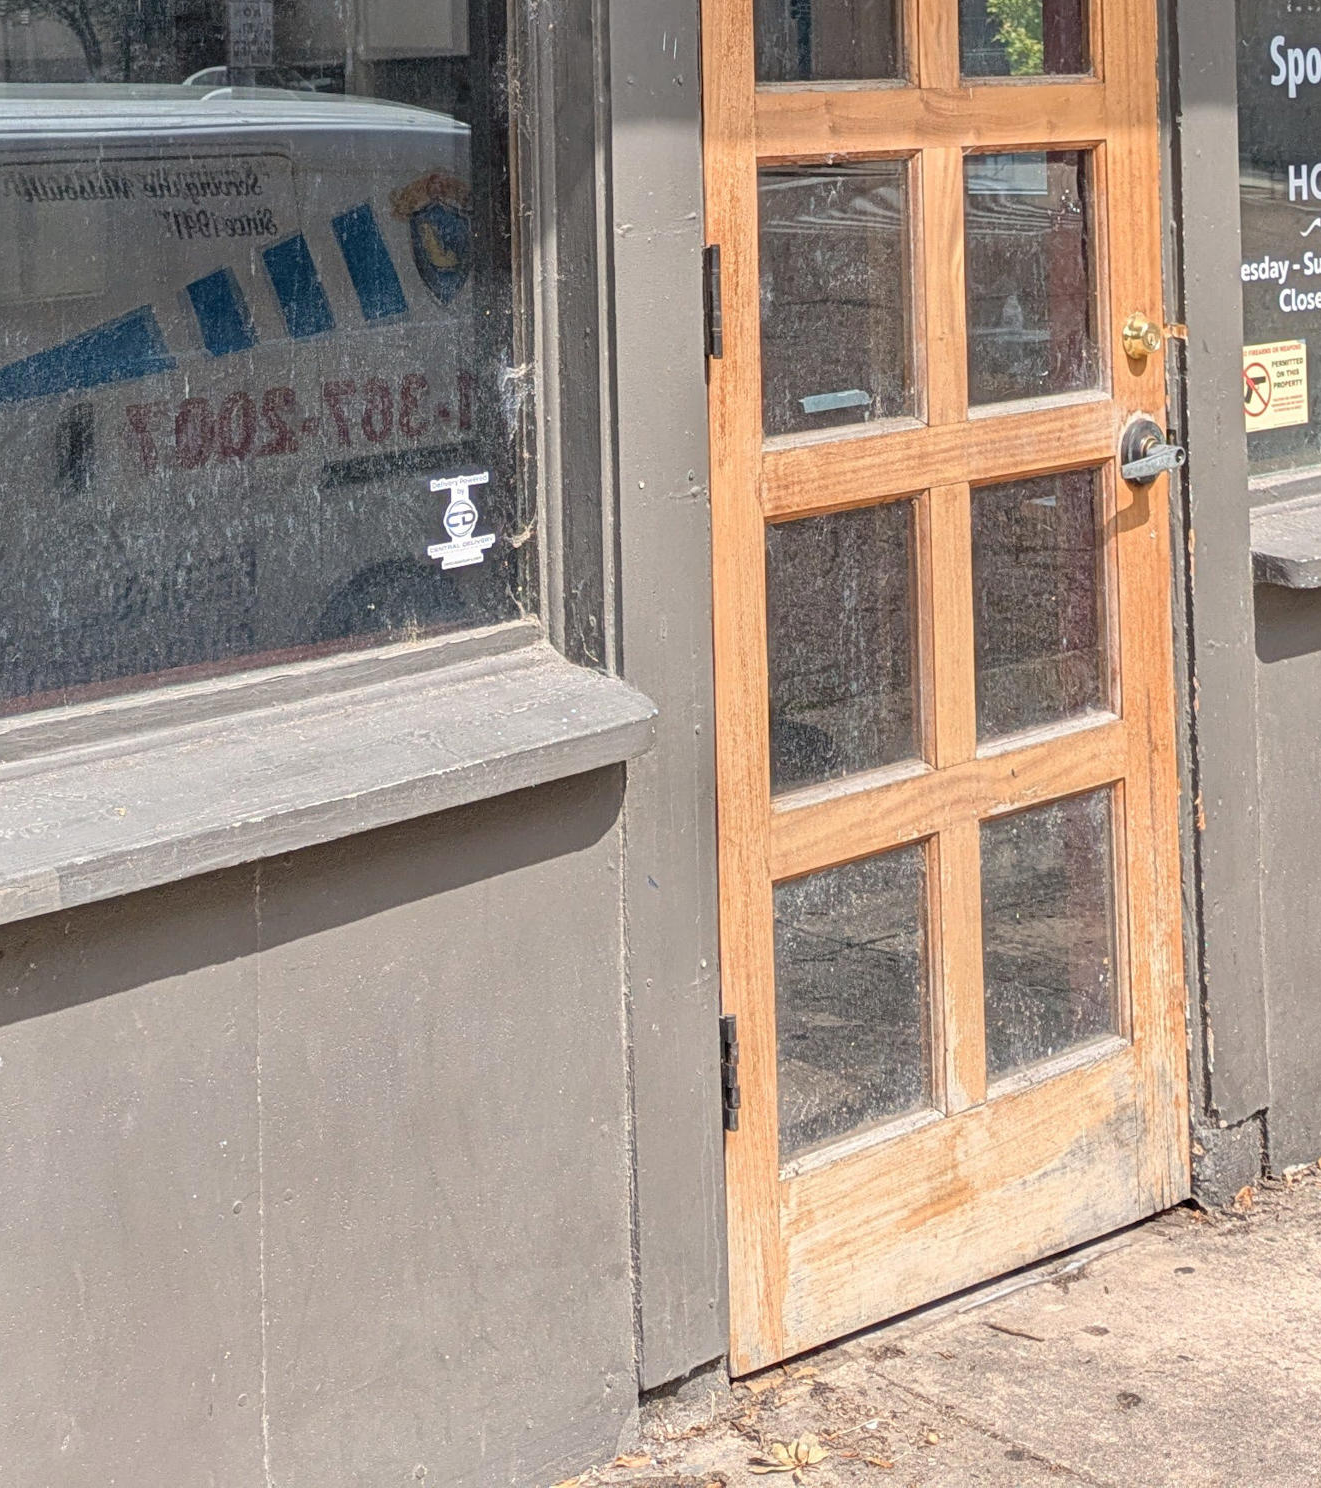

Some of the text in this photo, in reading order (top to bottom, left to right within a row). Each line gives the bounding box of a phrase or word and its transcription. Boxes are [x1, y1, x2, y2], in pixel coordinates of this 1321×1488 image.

[1248, 348, 1272, 356] FIREARMS
[1280, 344, 1301, 352] WEAPONS
[1271, 357, 1304, 368] PERMITTED
[1286, 369, 1300, 377] THIS
[1273, 379, 1303, 389] PROPERTY
[431, 475, 487, 490] Delivery Powered
[457, 487, 465, 495] by
[446, 509, 476, 528] CD
[429, 544, 461, 554] CENTRAL
[462, 537, 493, 548] DELIVERY
